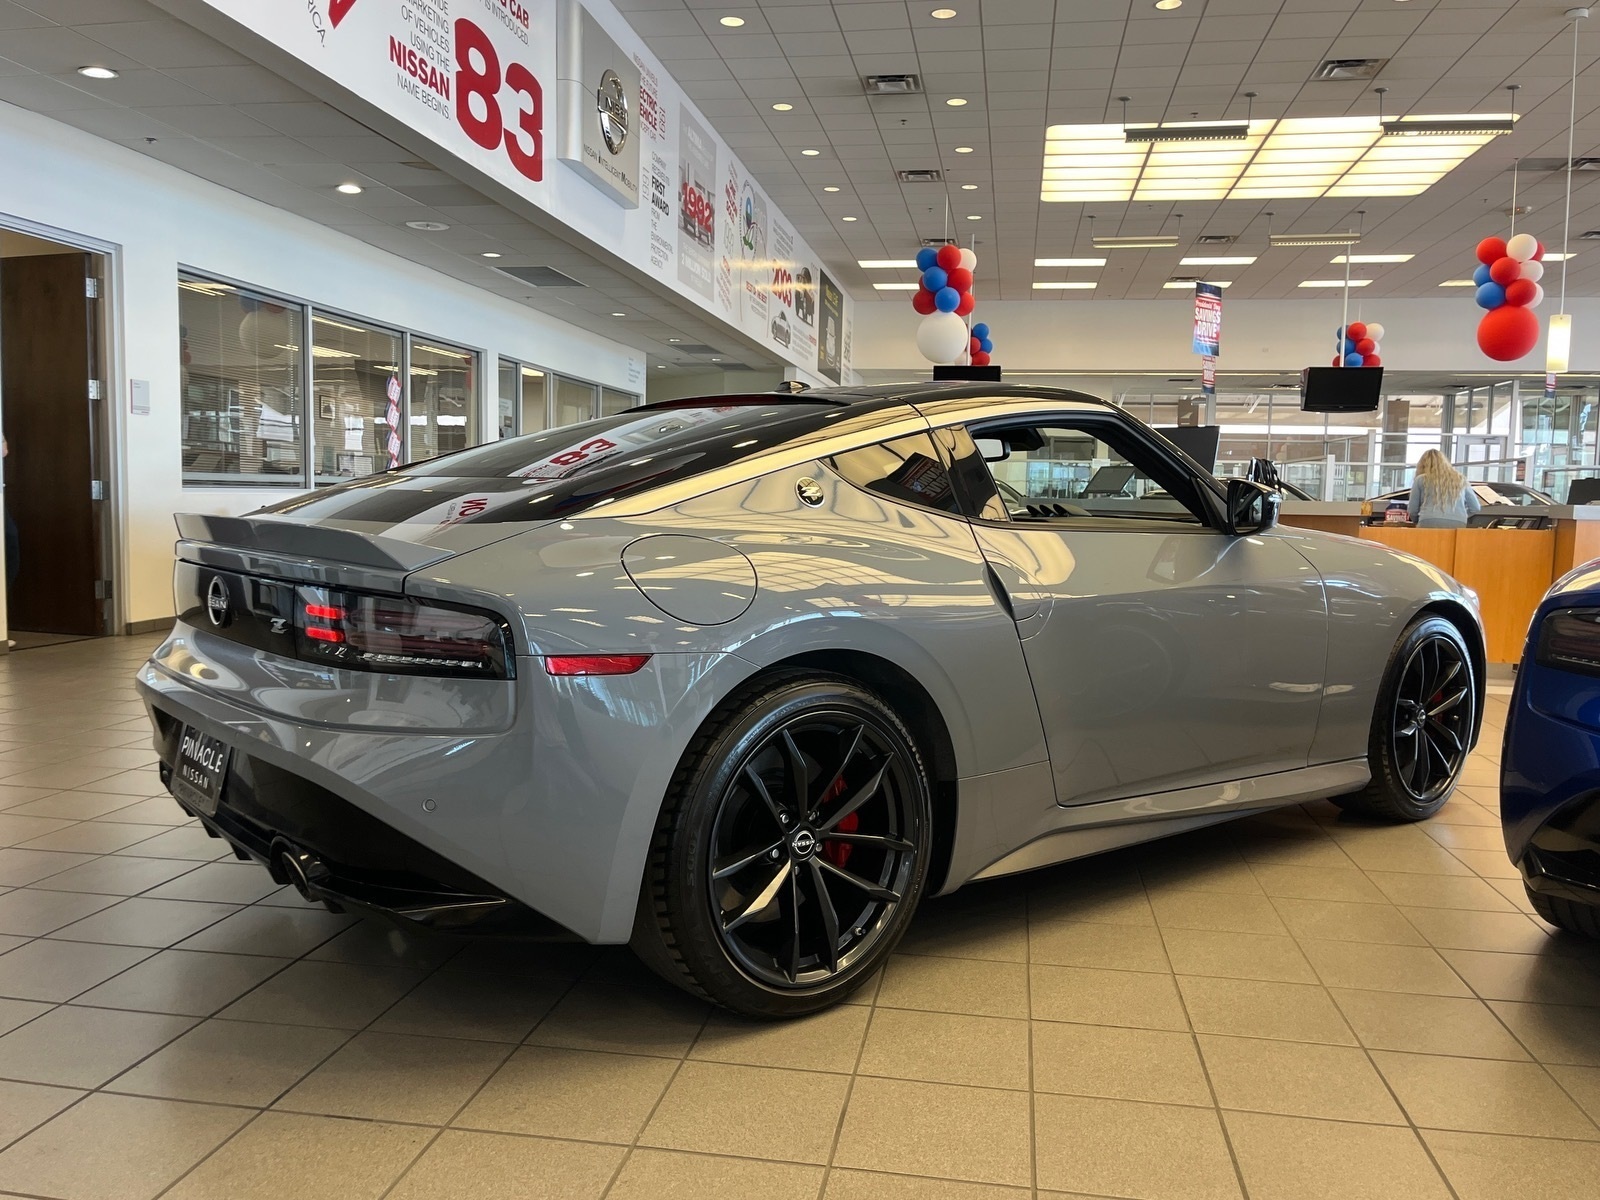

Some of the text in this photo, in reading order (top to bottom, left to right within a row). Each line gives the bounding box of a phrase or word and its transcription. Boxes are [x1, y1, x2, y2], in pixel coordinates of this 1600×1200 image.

[401, 5, 413, 23] OF
[413, 13, 450, 53] VEHICLES
[389, 34, 450, 101] NISSAN
[410, 31, 450, 73] USING THE
[396, 72, 451, 120] NAME BEGINS.
[454, 17, 543, 182] 83
[640, 85, 658, 115] ECTRIC
[640, 102, 658, 131] EHICLE
[651, 175, 666, 197] FIRST
[651, 192, 670, 217] AWARD
[682, 181, 713, 234] 1992
[1195, 307, 1221, 324] SAVINGS
[1197, 320, 1217, 338] DRIVE
[181, 736, 223, 773] PINNACLE
[183, 764, 209, 789] NISSAN
